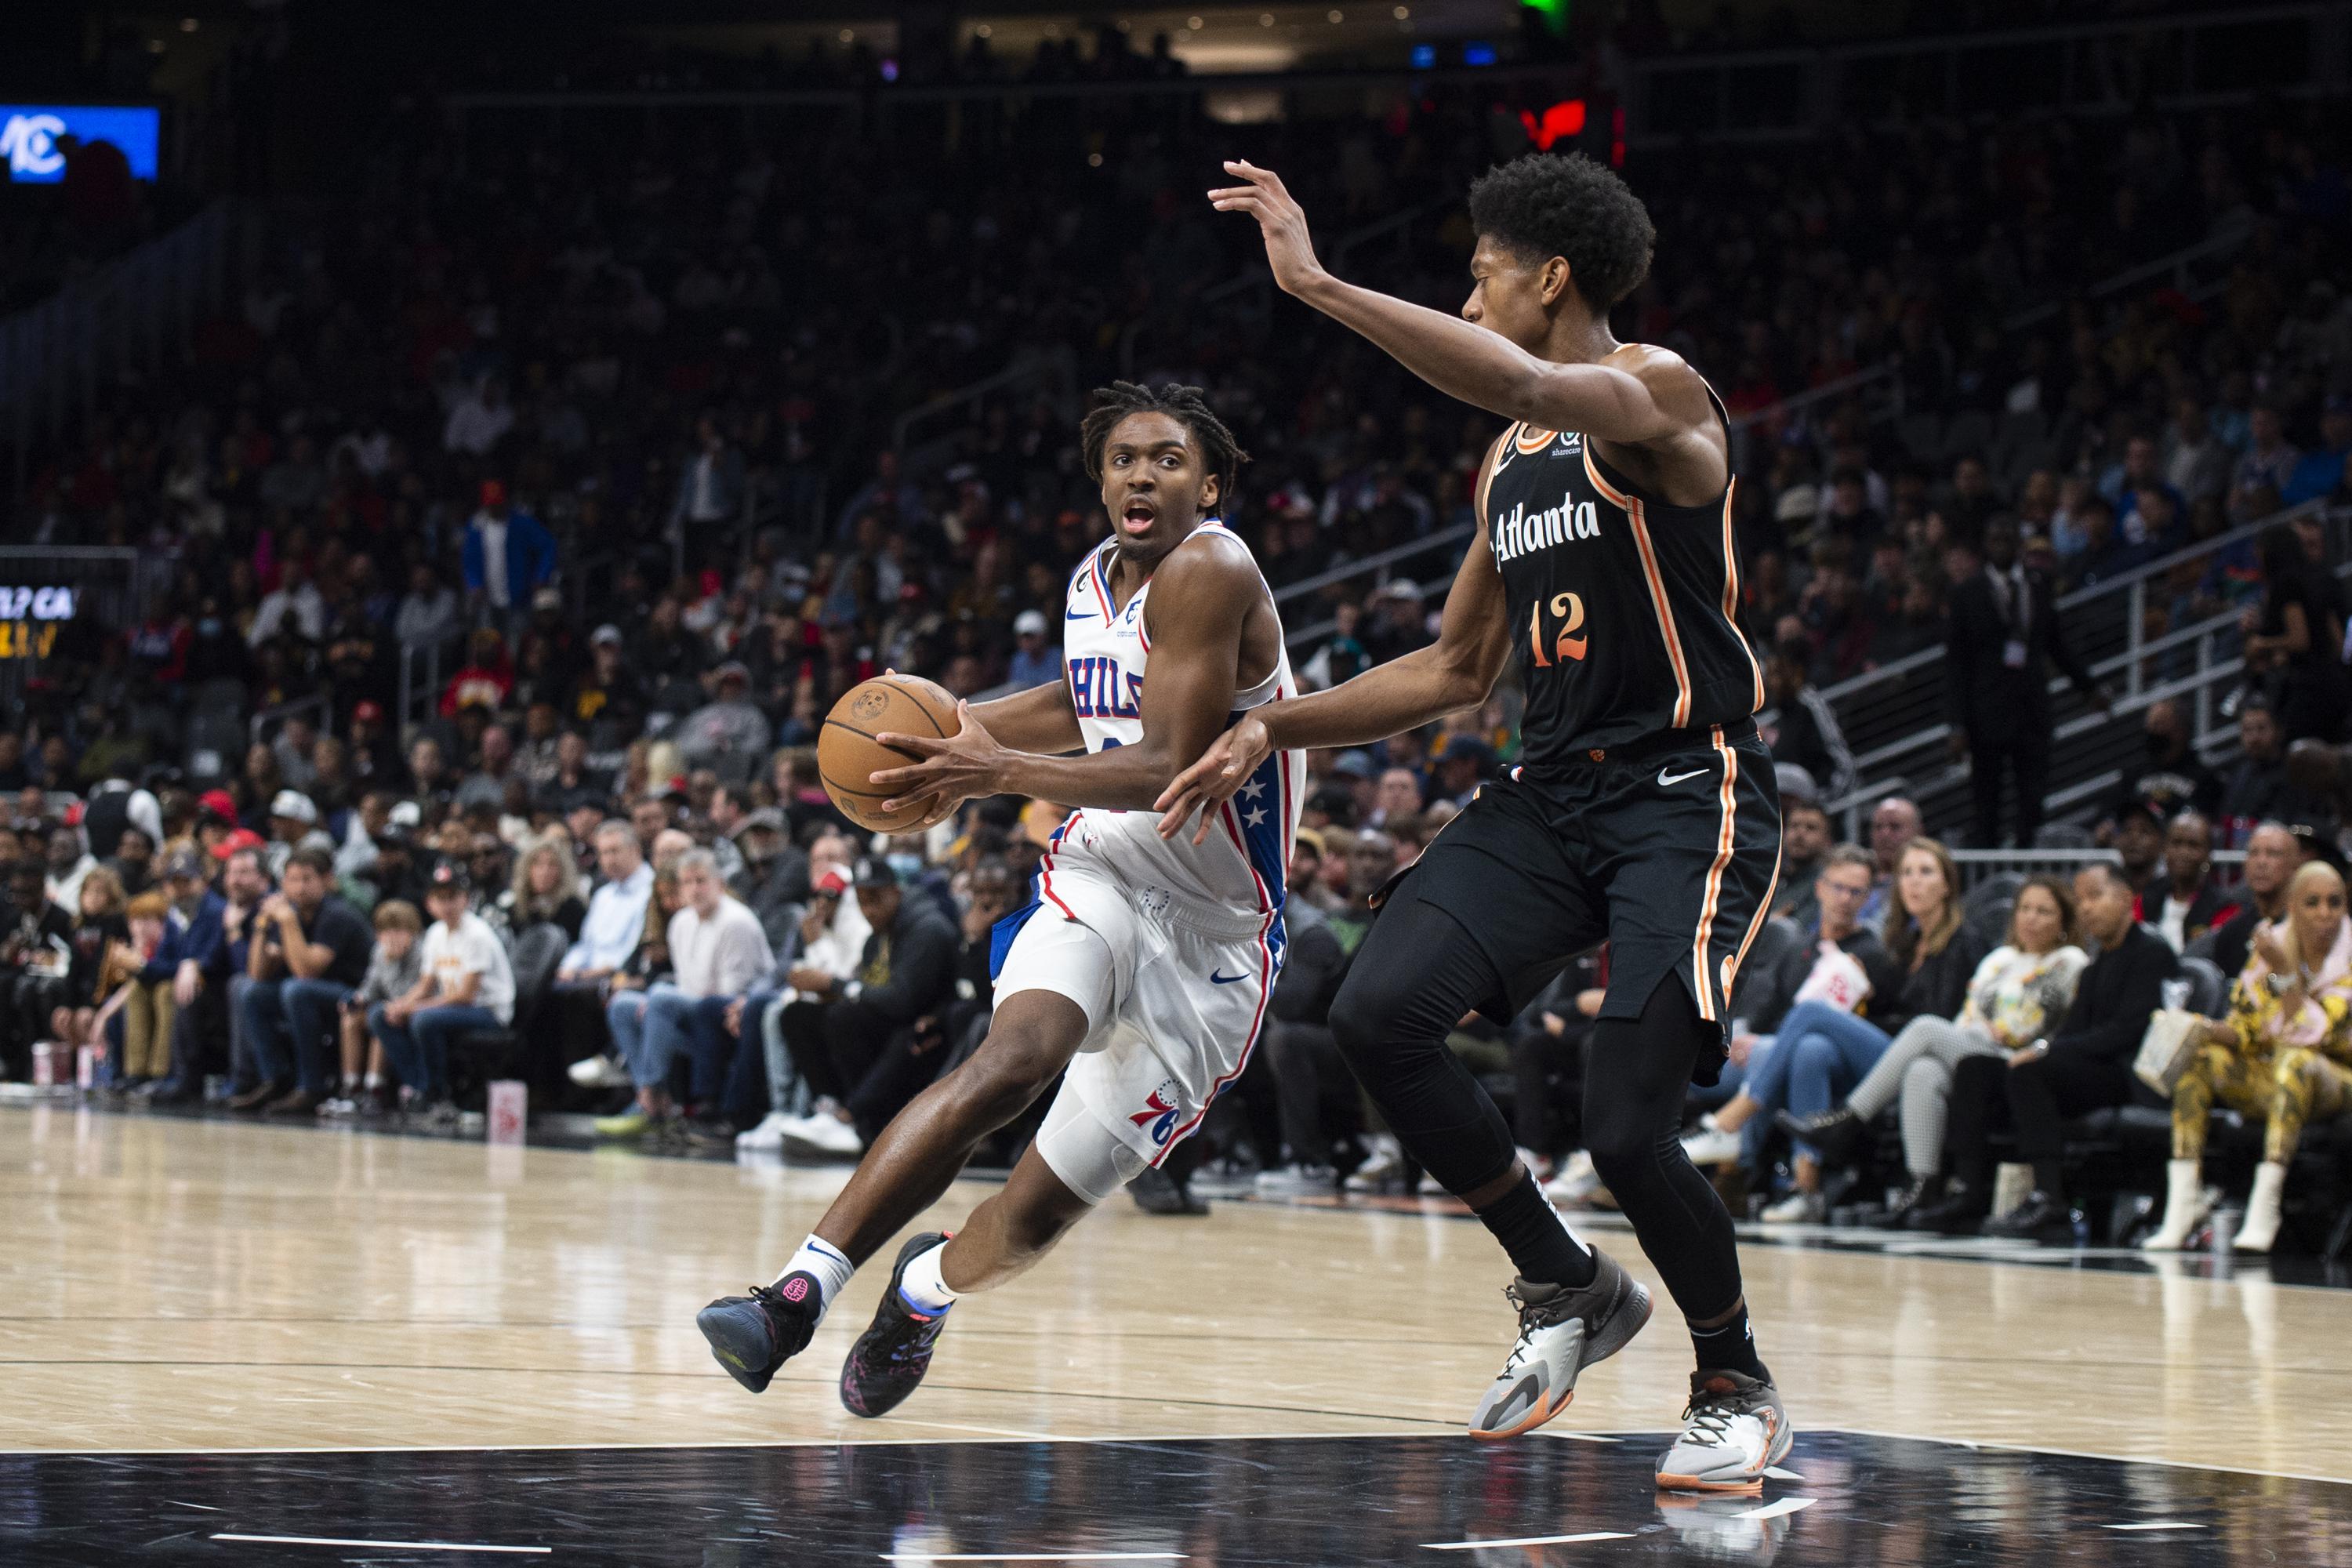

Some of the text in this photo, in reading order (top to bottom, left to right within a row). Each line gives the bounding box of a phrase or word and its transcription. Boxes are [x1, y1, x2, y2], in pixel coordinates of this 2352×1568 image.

[1552, 448, 1581, 456] sharecare
[1490, 492, 1601, 573] Atlanta
[1530, 592, 1588, 666] 12
[1128, 1085, 1181, 1146] 76
